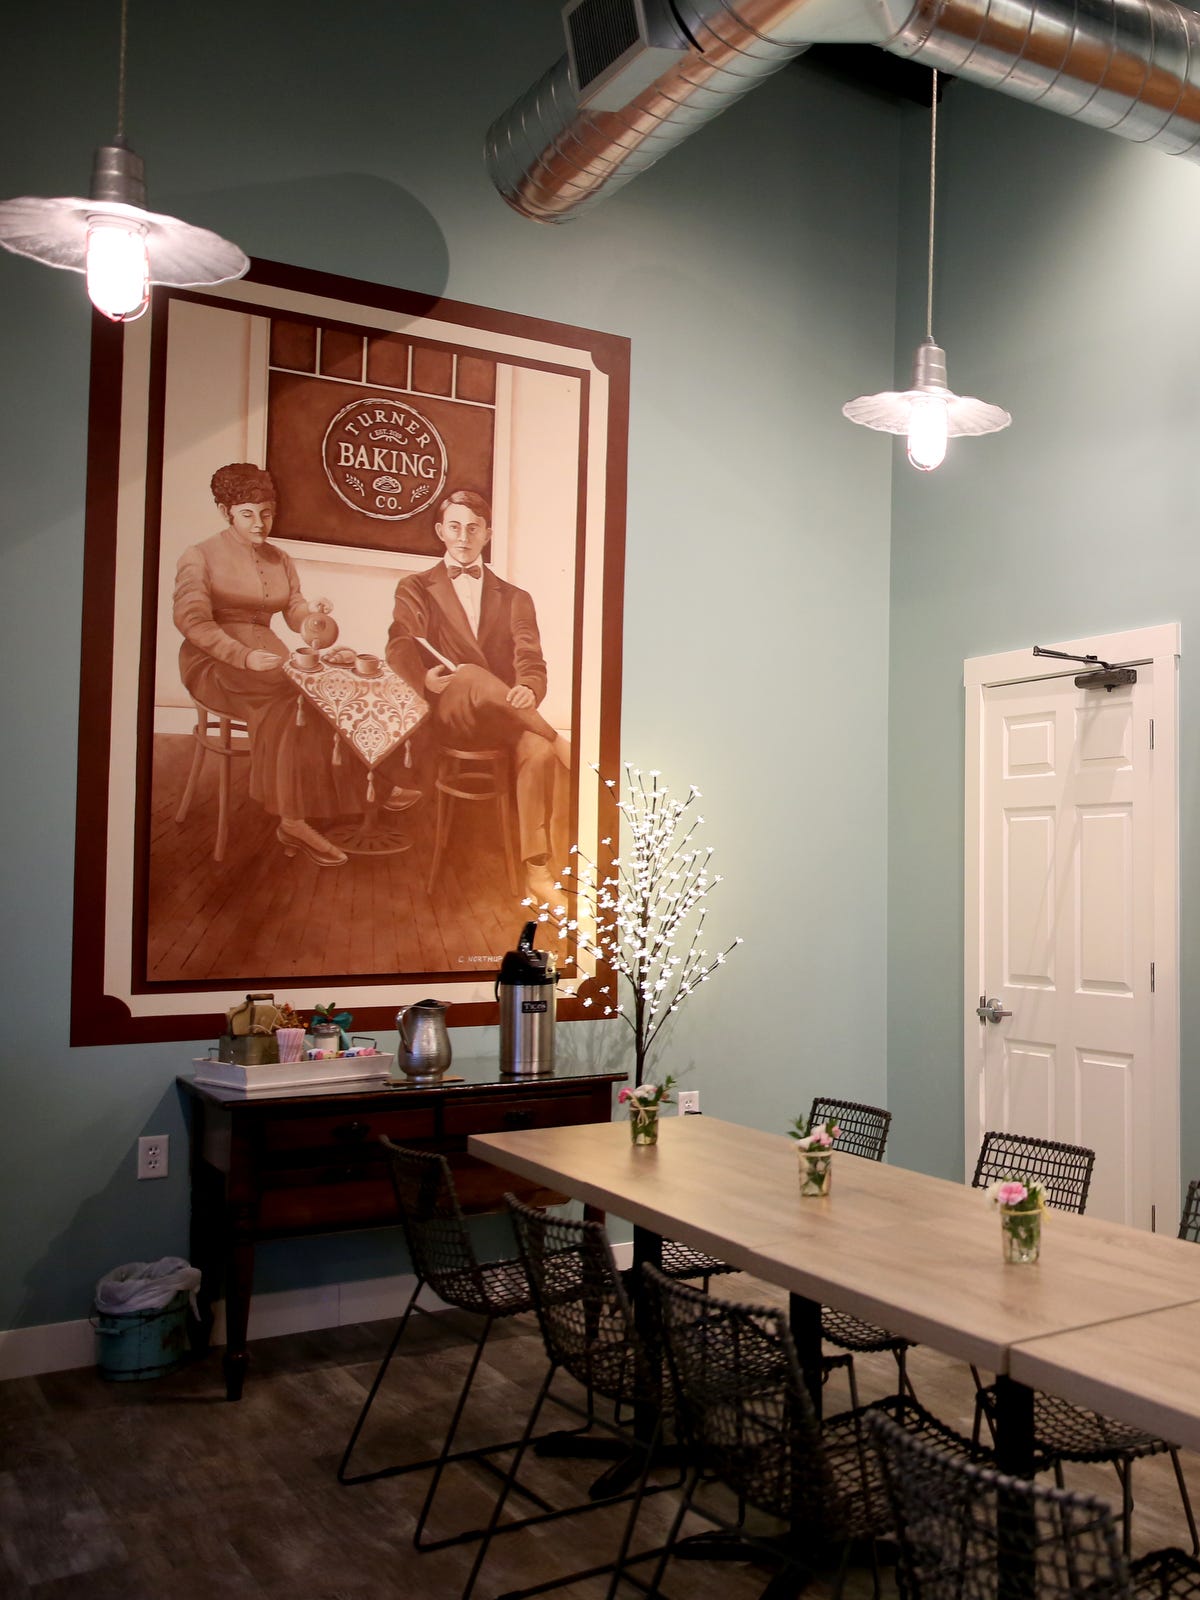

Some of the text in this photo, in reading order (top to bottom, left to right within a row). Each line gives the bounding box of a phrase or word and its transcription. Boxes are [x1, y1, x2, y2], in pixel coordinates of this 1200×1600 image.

[345, 409, 431, 449] TURNER
[337, 442, 437, 479] BAKING
[375, 495, 402, 510] CO.
